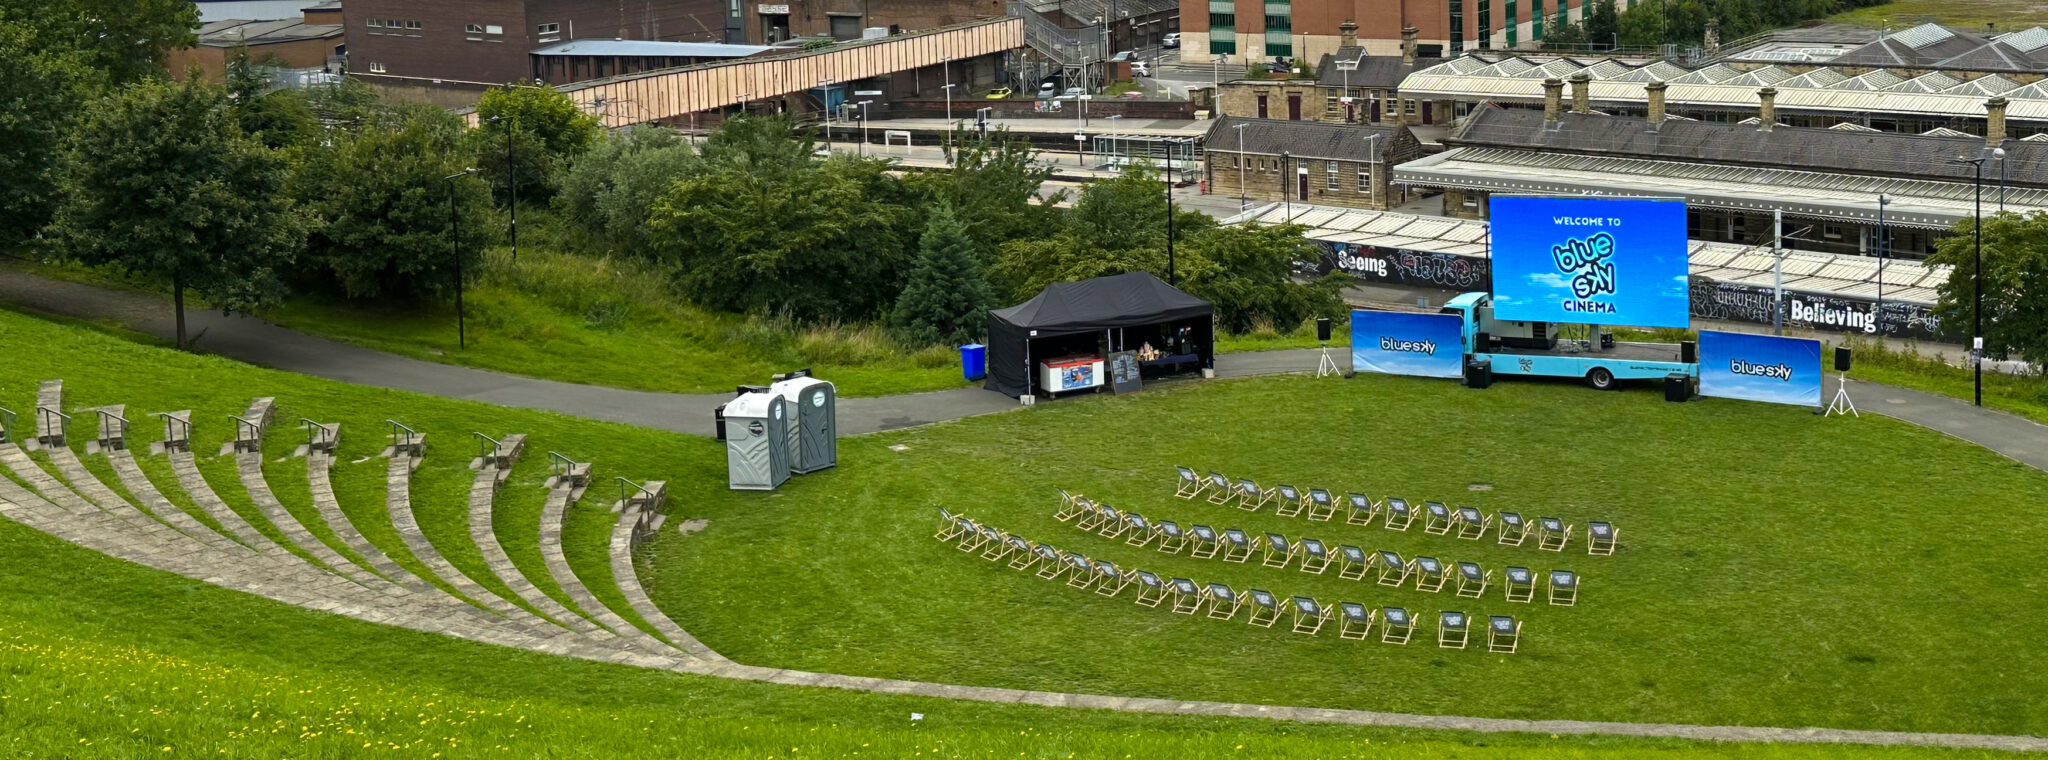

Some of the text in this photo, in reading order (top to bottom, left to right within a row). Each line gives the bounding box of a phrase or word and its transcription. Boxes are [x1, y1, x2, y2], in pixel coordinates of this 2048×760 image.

[1553, 216, 1621, 227] WELCOME TO
[1338, 250, 1388, 277] Seeing
[1553, 233, 1614, 273] blue
[1573, 263, 1614, 298] sky
[1563, 300, 1617, 314] CINEMA
[1791, 299, 1876, 333] Believing
